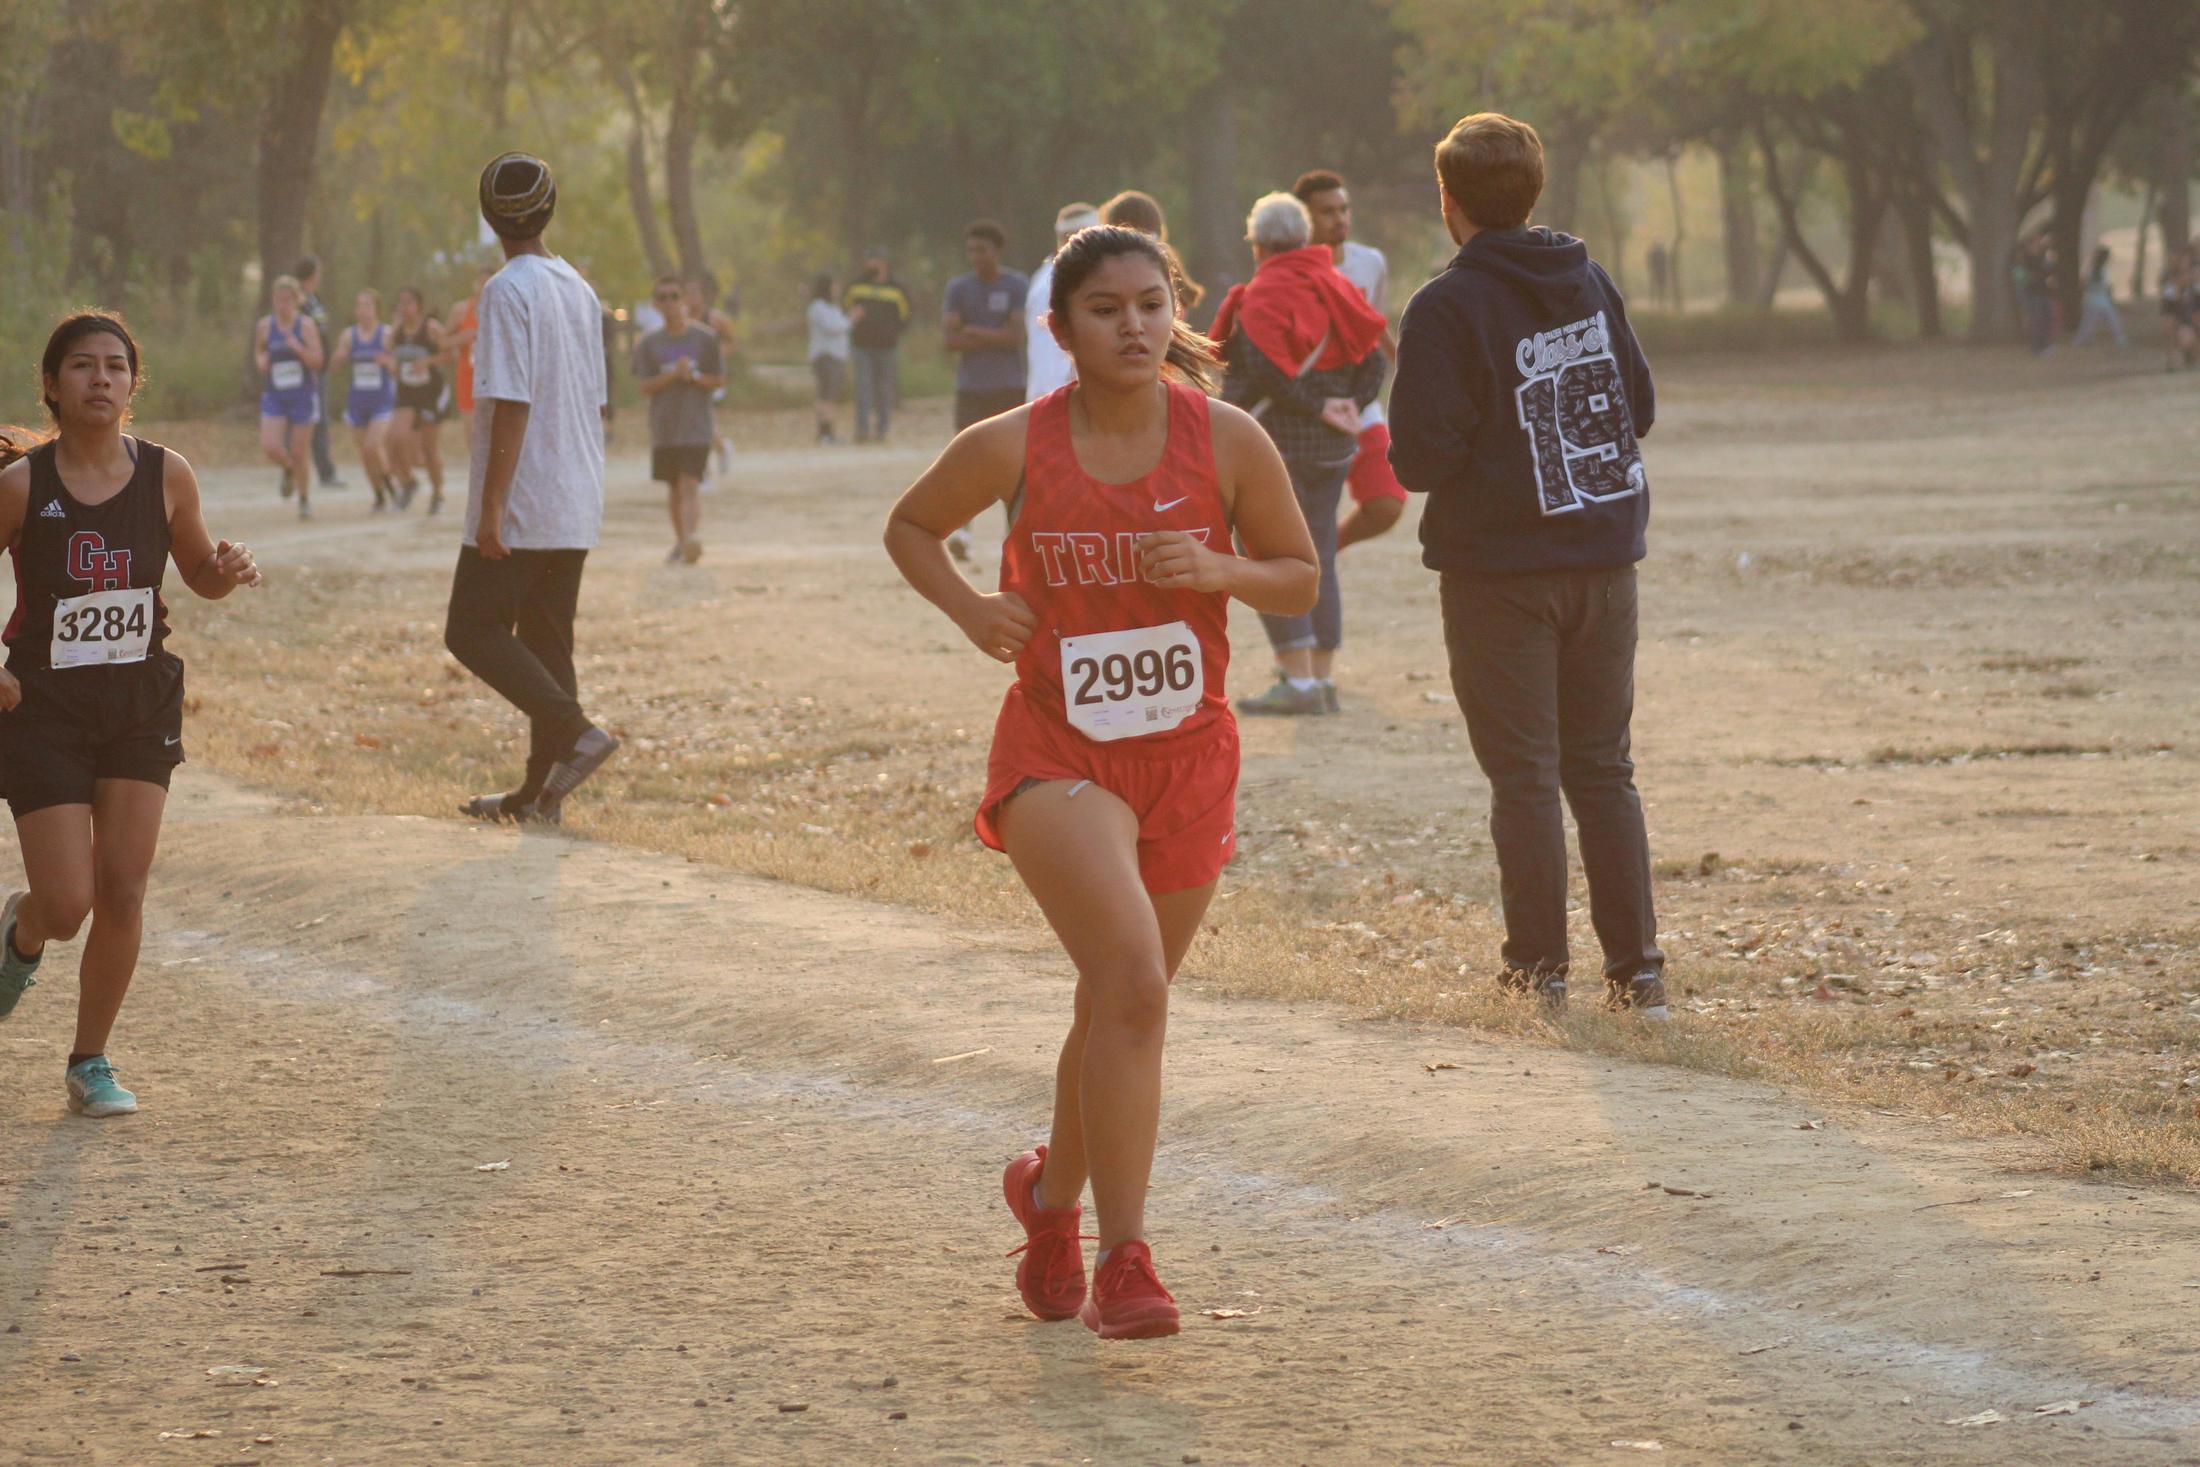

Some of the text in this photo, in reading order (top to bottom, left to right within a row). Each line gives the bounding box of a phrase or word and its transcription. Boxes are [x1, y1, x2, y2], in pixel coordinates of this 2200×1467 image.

[1515, 310, 1609, 378] Class of
[40, 509, 66, 518] adidas
[1032, 528, 1210, 586] TRI
[58, 603, 147, 642] 3284
[1070, 643, 1195, 706] 2996
